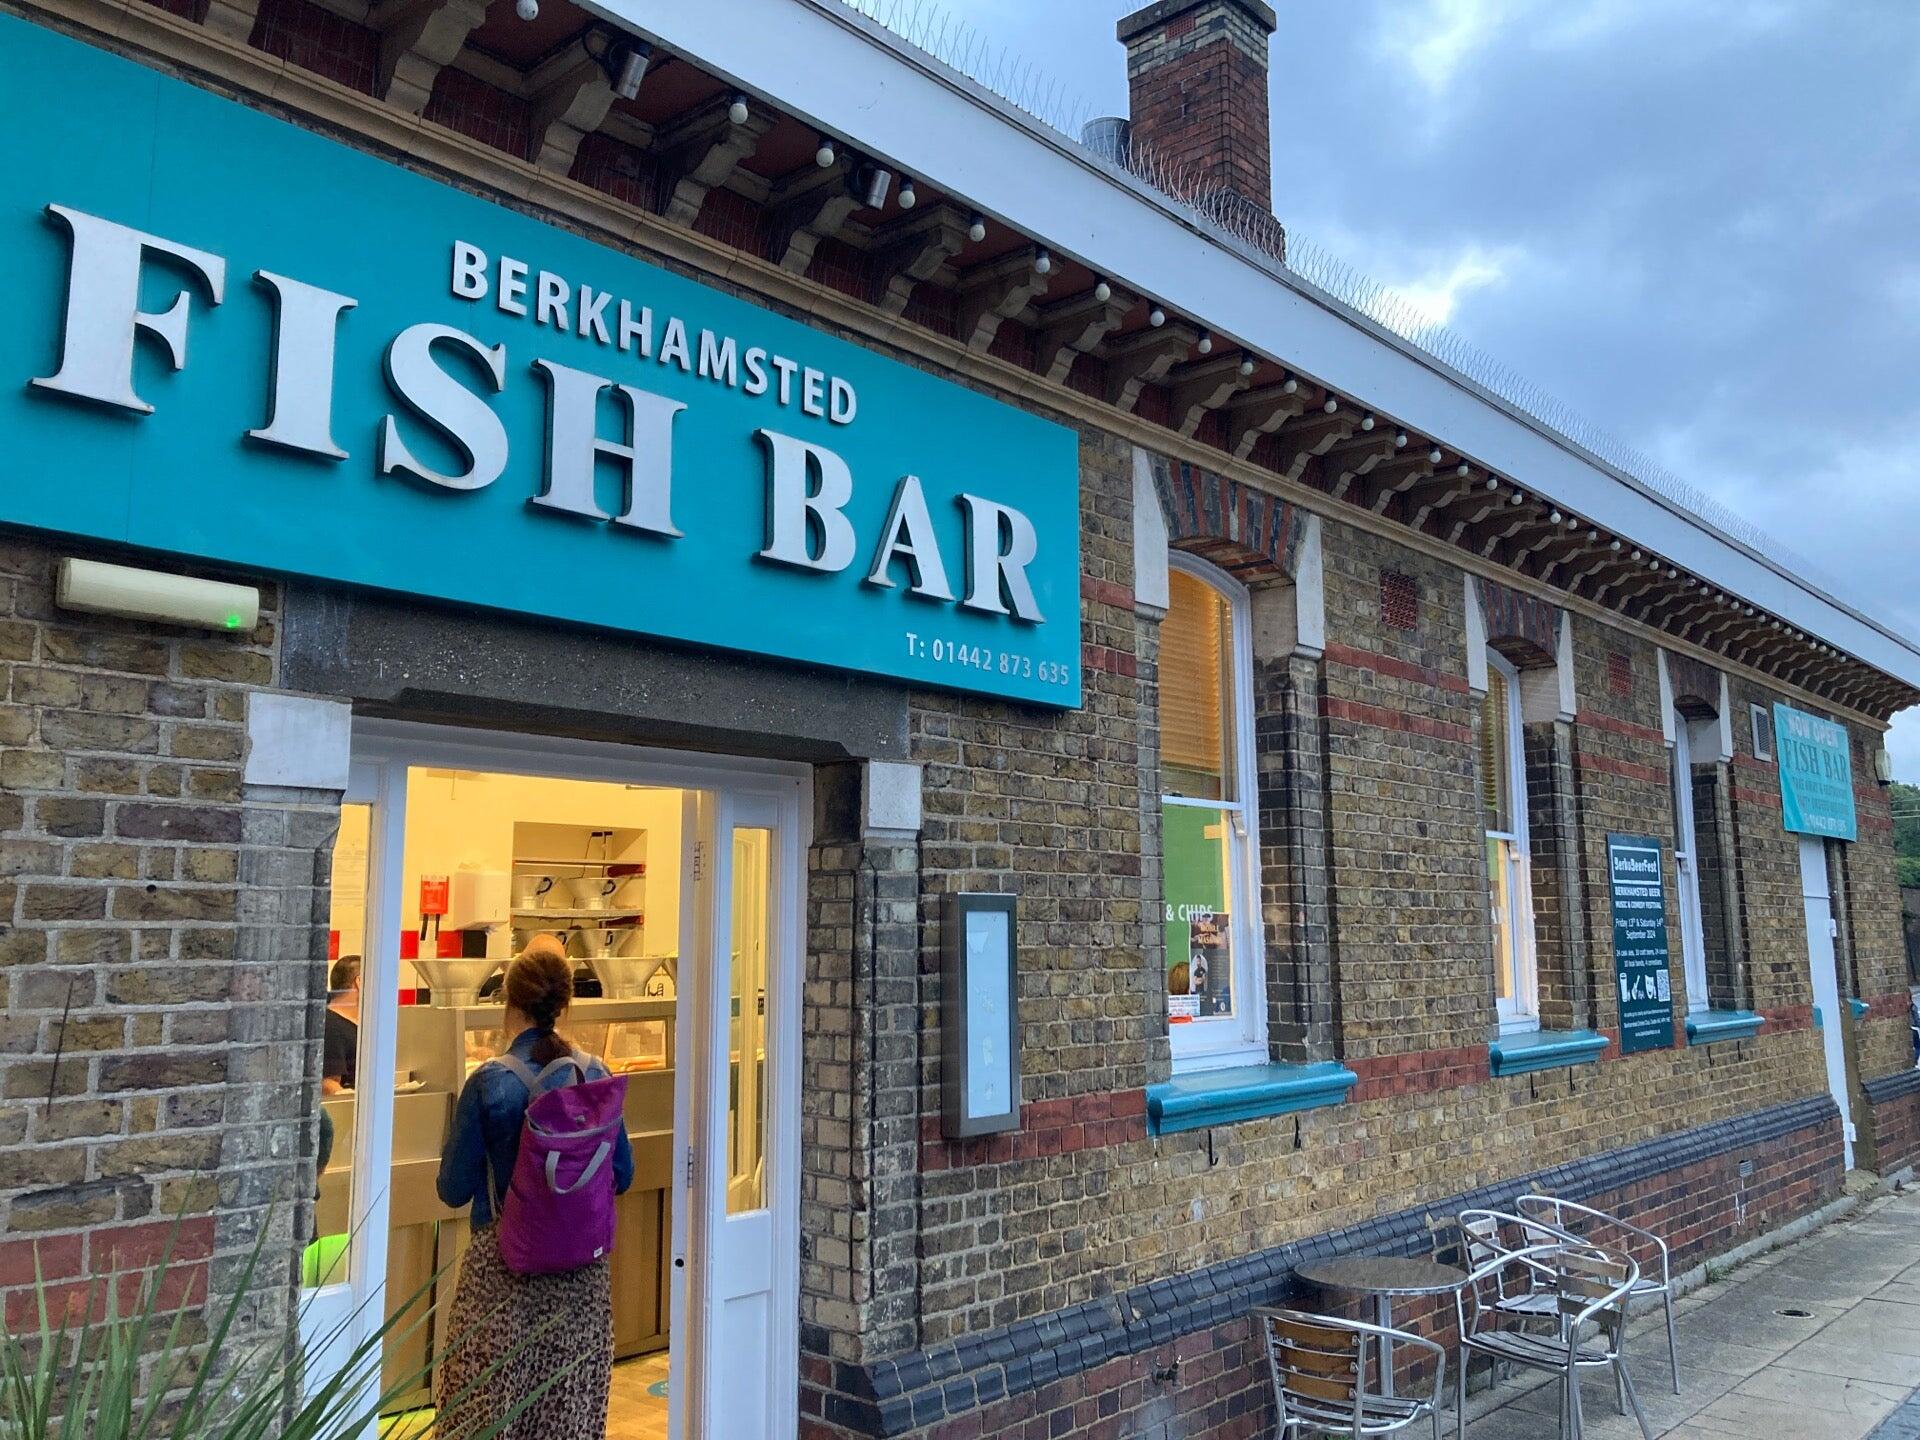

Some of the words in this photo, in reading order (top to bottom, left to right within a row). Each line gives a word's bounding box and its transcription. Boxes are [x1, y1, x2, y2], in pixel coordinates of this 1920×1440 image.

[452, 239, 858, 425] BERKHAMSTED
[30, 202, 688, 540] FISH
[753, 427, 1047, 625] BAR
[906, 631, 925, 658] T:
[932, 638, 992, 671] 01442
[999, 652, 1032, 678] 873
[1038, 660, 1070, 685] 635
[1788, 715, 1810, 739] NOW
[1813, 721, 1839, 748] OPEN
[1782, 737, 1820, 775] FISH
[1822, 749, 1848, 784] BAR
[1614, 857, 1657, 873] BerkoBeerFest
[1615, 886, 1648, 896] BERKHAMSTED
[1649, 888, 1661, 897] BEER
[1165, 904, 1175, 922] &
[1178, 904, 1214, 922] CHIPS
[1615, 918, 1628, 928] Friday
[1640, 919, 1656, 928] Saturday
[1626, 930, 1646, 940] September
